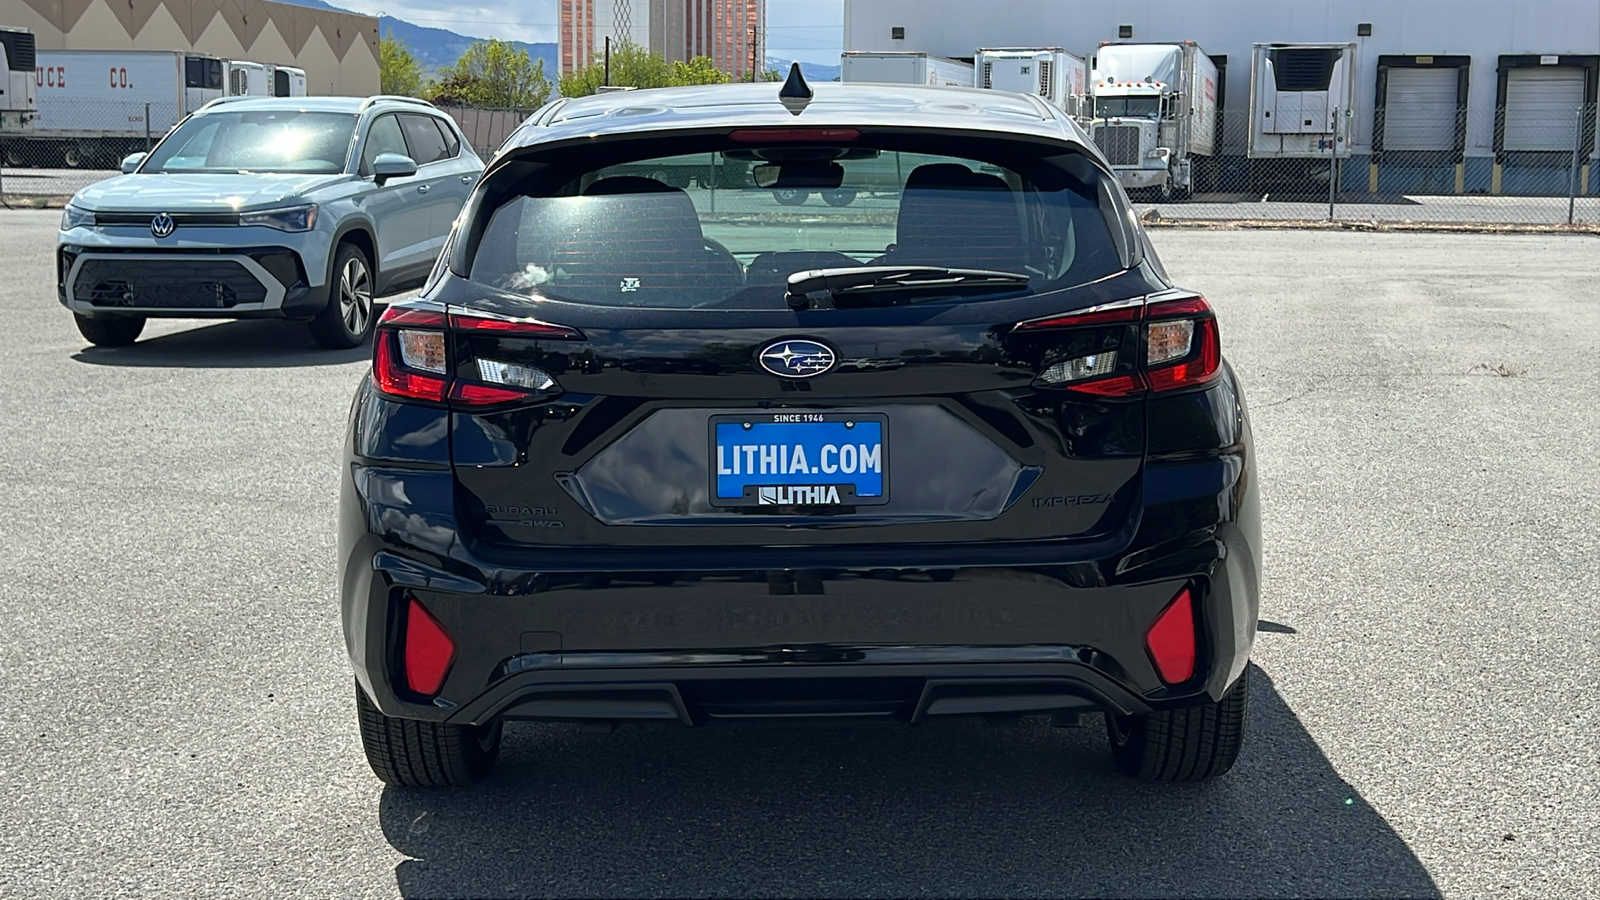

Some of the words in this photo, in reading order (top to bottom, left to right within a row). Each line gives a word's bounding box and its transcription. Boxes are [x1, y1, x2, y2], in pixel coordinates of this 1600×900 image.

[110, 67, 133, 89] CO.
[773, 414, 801, 423] SINCE
[803, 414, 824, 422] 1946
[717, 444, 881, 475] LITHIA.COM
[777, 486, 841, 505] LITHIA
[1031, 493, 1117, 508] IMPREZA
[485, 504, 558, 516] SUBARU
[516, 519, 565, 528] AWD
